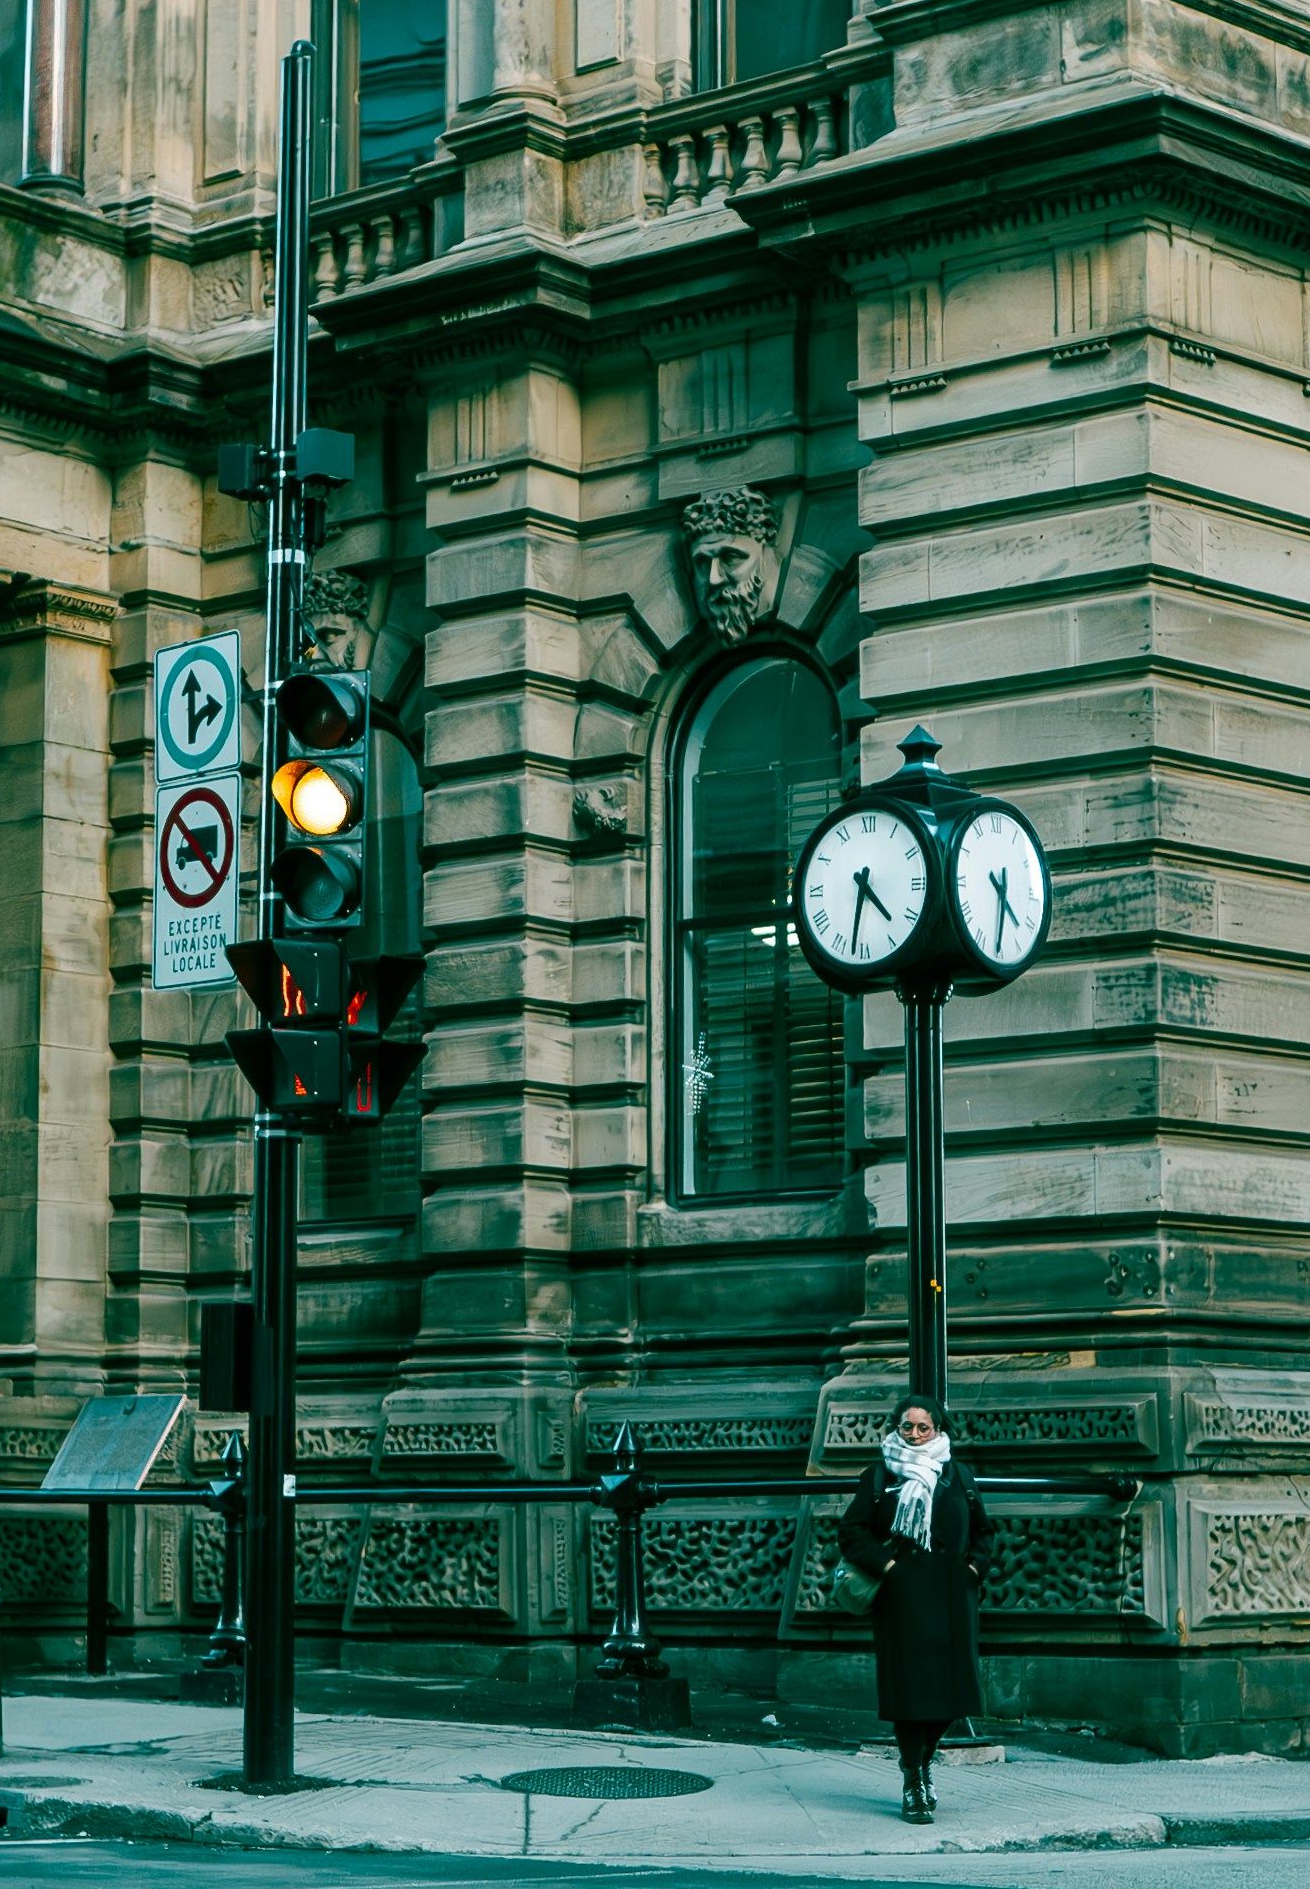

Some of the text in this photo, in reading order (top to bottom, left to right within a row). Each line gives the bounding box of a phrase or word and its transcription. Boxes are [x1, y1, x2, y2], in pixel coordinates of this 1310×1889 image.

[168, 911, 222, 937] EXCEPTÉ
[164, 932, 227, 956] LIVRAISON
[172, 952, 216, 973] LOCALE
